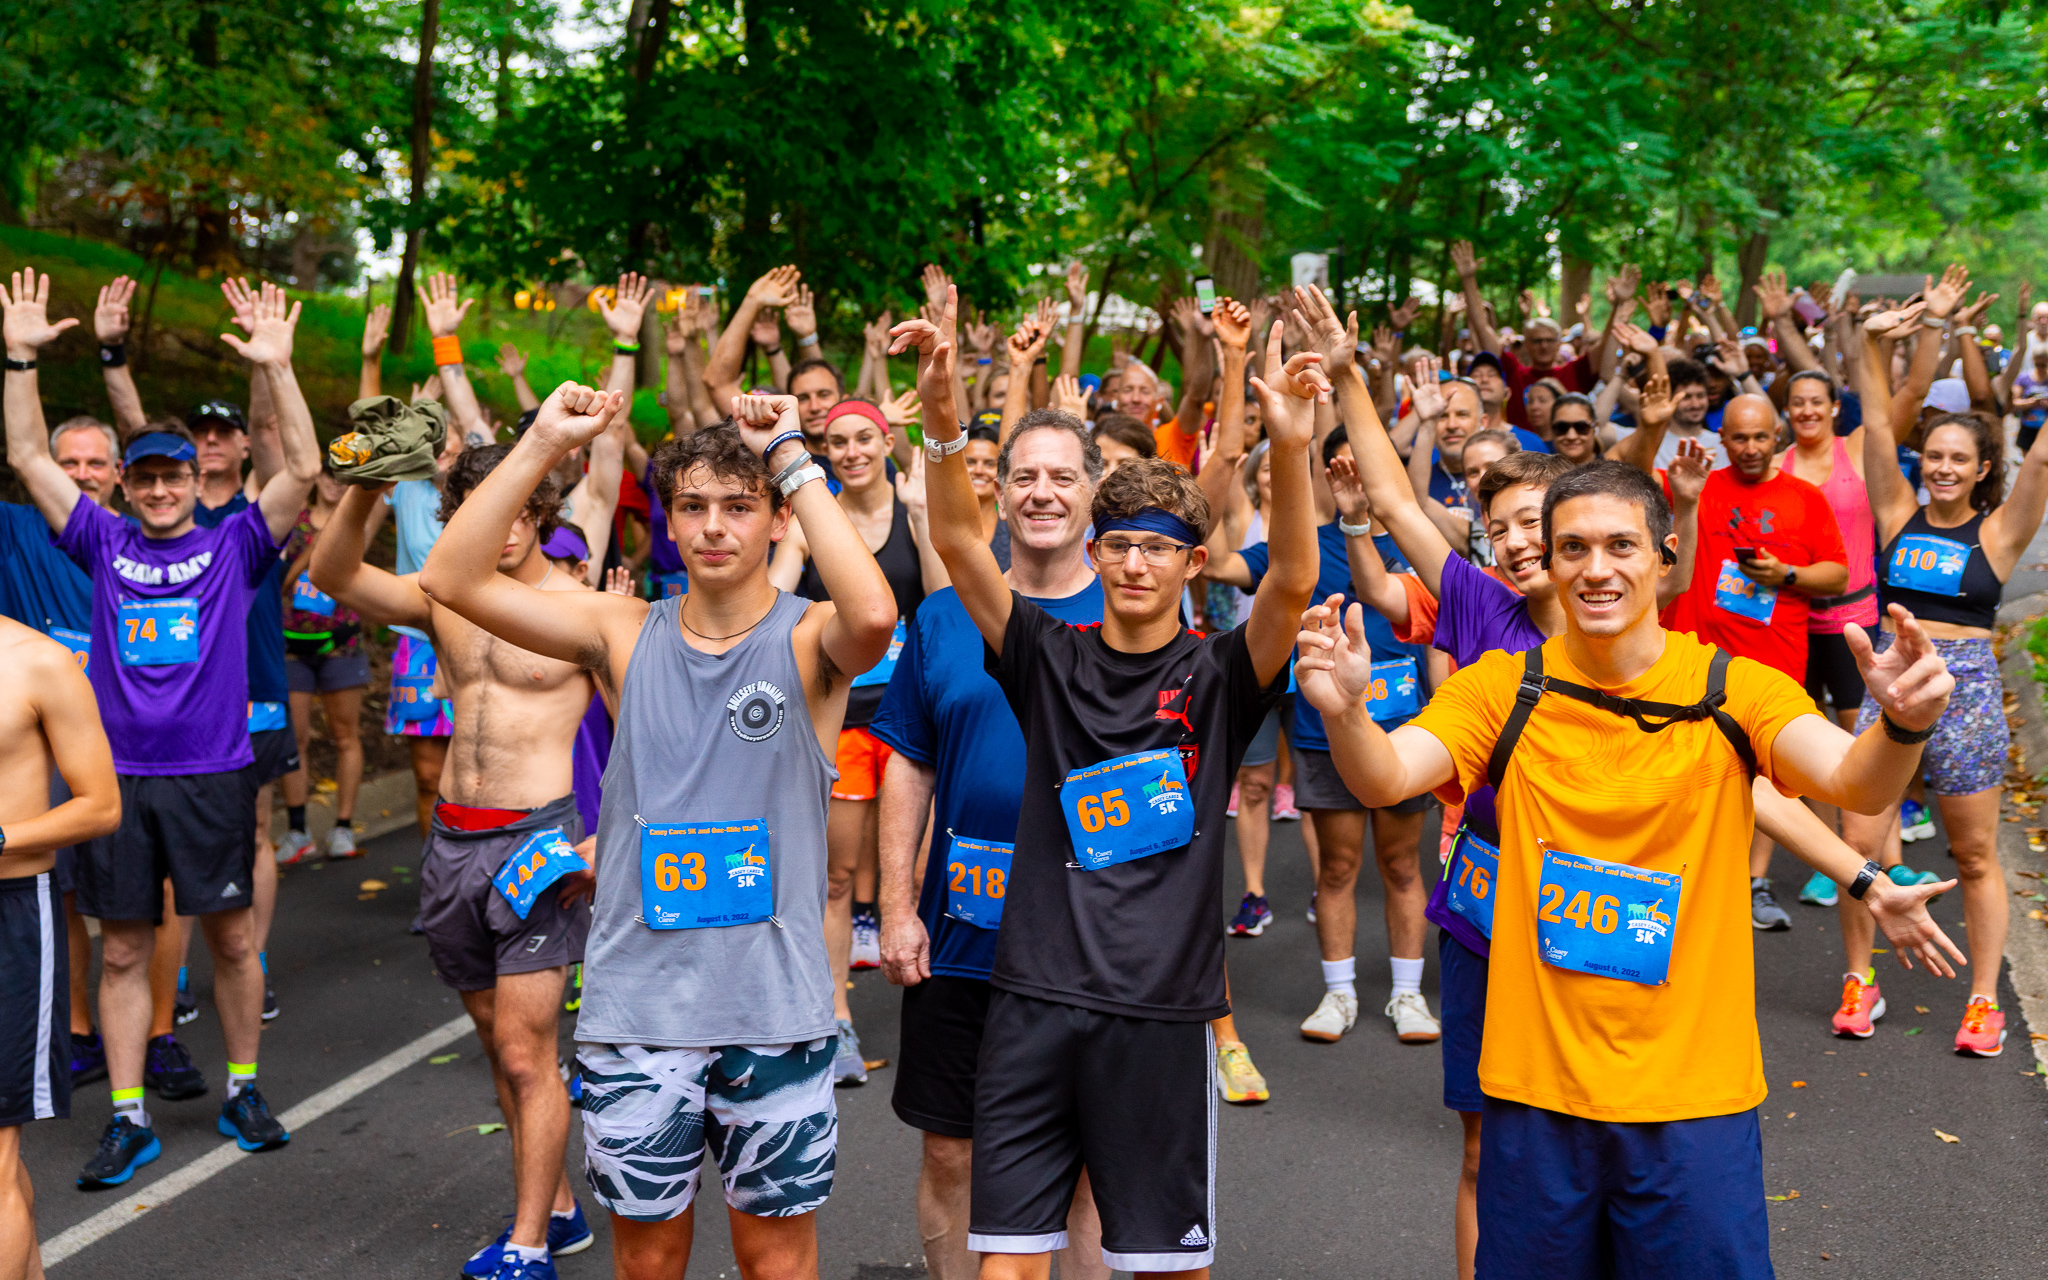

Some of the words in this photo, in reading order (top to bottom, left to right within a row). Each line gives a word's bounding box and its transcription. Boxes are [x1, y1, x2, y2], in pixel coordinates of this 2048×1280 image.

[112, 554, 162, 585] TEAM
[167, 551, 212, 584] AMY
[1895, 547, 1936, 570] 110
[1718, 574, 1756, 599] 204
[125, 618, 158, 643] 74
[726, 682, 756, 711] BULLSEYE
[1066, 774, 1082, 782] Casey
[1083, 770, 1100, 778] Cares
[1112, 763, 1124, 771] and
[1124, 756, 1152, 768] One-Mile
[1077, 788, 1130, 833] 65
[1159, 801, 1178, 814] 5K
[650, 828, 667, 836] Casey
[1130, 844, 1152, 855] August
[1162, 837, 1178, 846] 2022
[506, 851, 546, 898] 144
[654, 852, 706, 892] 63
[738, 875, 756, 888] 5K
[949, 862, 1006, 899] 218
[1458, 854, 1490, 900] 76
[1552, 857, 1572, 868] Casey
[1573, 861, 1593, 870] Cares
[1605, 868, 1619, 876] and
[1620, 870, 1652, 882] One-Mile
[1653, 877, 1670, 886] Walk
[697, 916, 721, 924] August
[1538, 883, 1620, 934] 246
[1635, 929, 1656, 944] 5K
[1648, 924, 1662, 932] CARES
[1546, 951, 1562, 960] Cares
[1550, 947, 1568, 956] Casey
[1584, 960, 1610, 971] August
[1612, 966, 1619, 974] 6,
[1621, 968, 1640, 978] 2022
[1180, 1238, 1208, 1246] adidas
